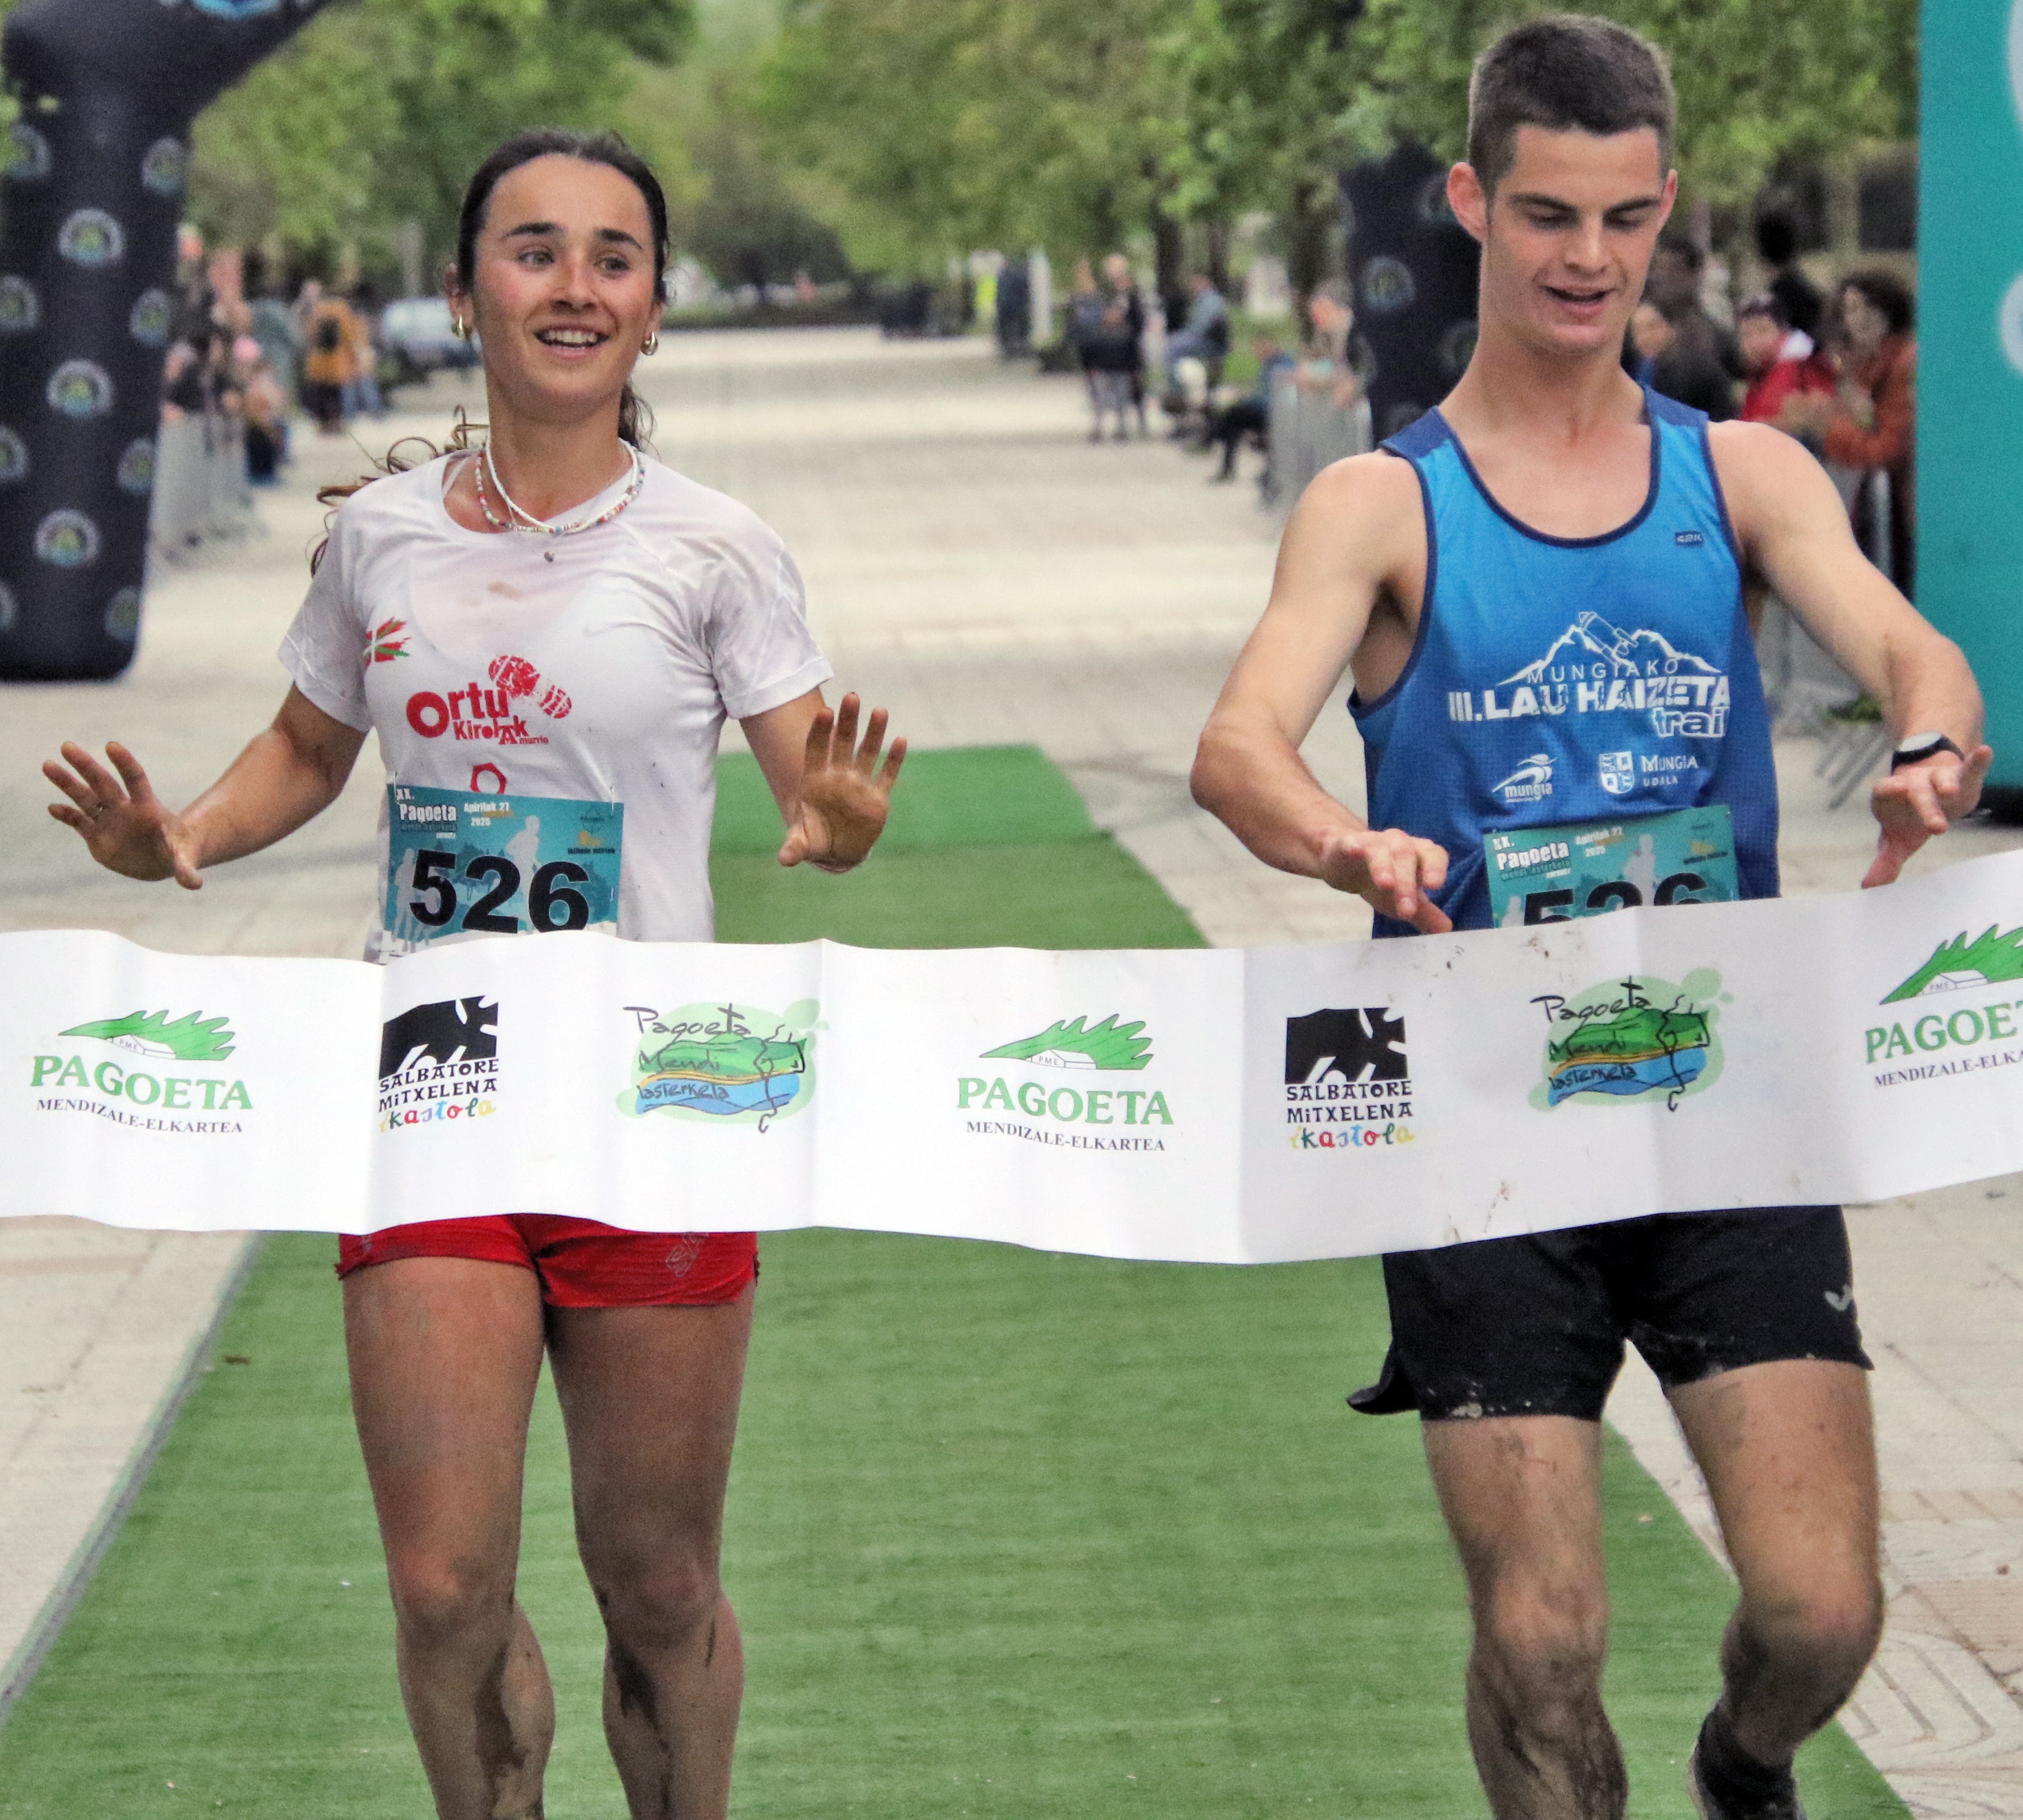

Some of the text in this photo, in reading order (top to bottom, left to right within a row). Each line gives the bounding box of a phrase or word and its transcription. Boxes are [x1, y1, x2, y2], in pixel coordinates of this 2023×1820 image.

[1526, 658, 1678, 684] MUNGIAKO
[1576, 675, 1730, 712] HAIZETA
[406, 682, 509, 738] Ortu
[1505, 782, 1553, 801] mungia
[1643, 775, 1679, 787] UDALA
[399, 803, 457, 823] Pagoeta
[1497, 842, 1570, 870] Pagoeta
[409, 849, 589, 934] 526
[30, 1055, 253, 1109] PAGOETA
[380, 1059, 499, 1093] SALBATORE
[1286, 1081, 1412, 1101] SALBATORE
[36, 1099, 243, 1133] MENDIZALE-ELKARTEA
[957, 1077, 1174, 1125] PAGOETA
[967, 1121, 1166, 1151] MENDIZALE-ELKARTEA
